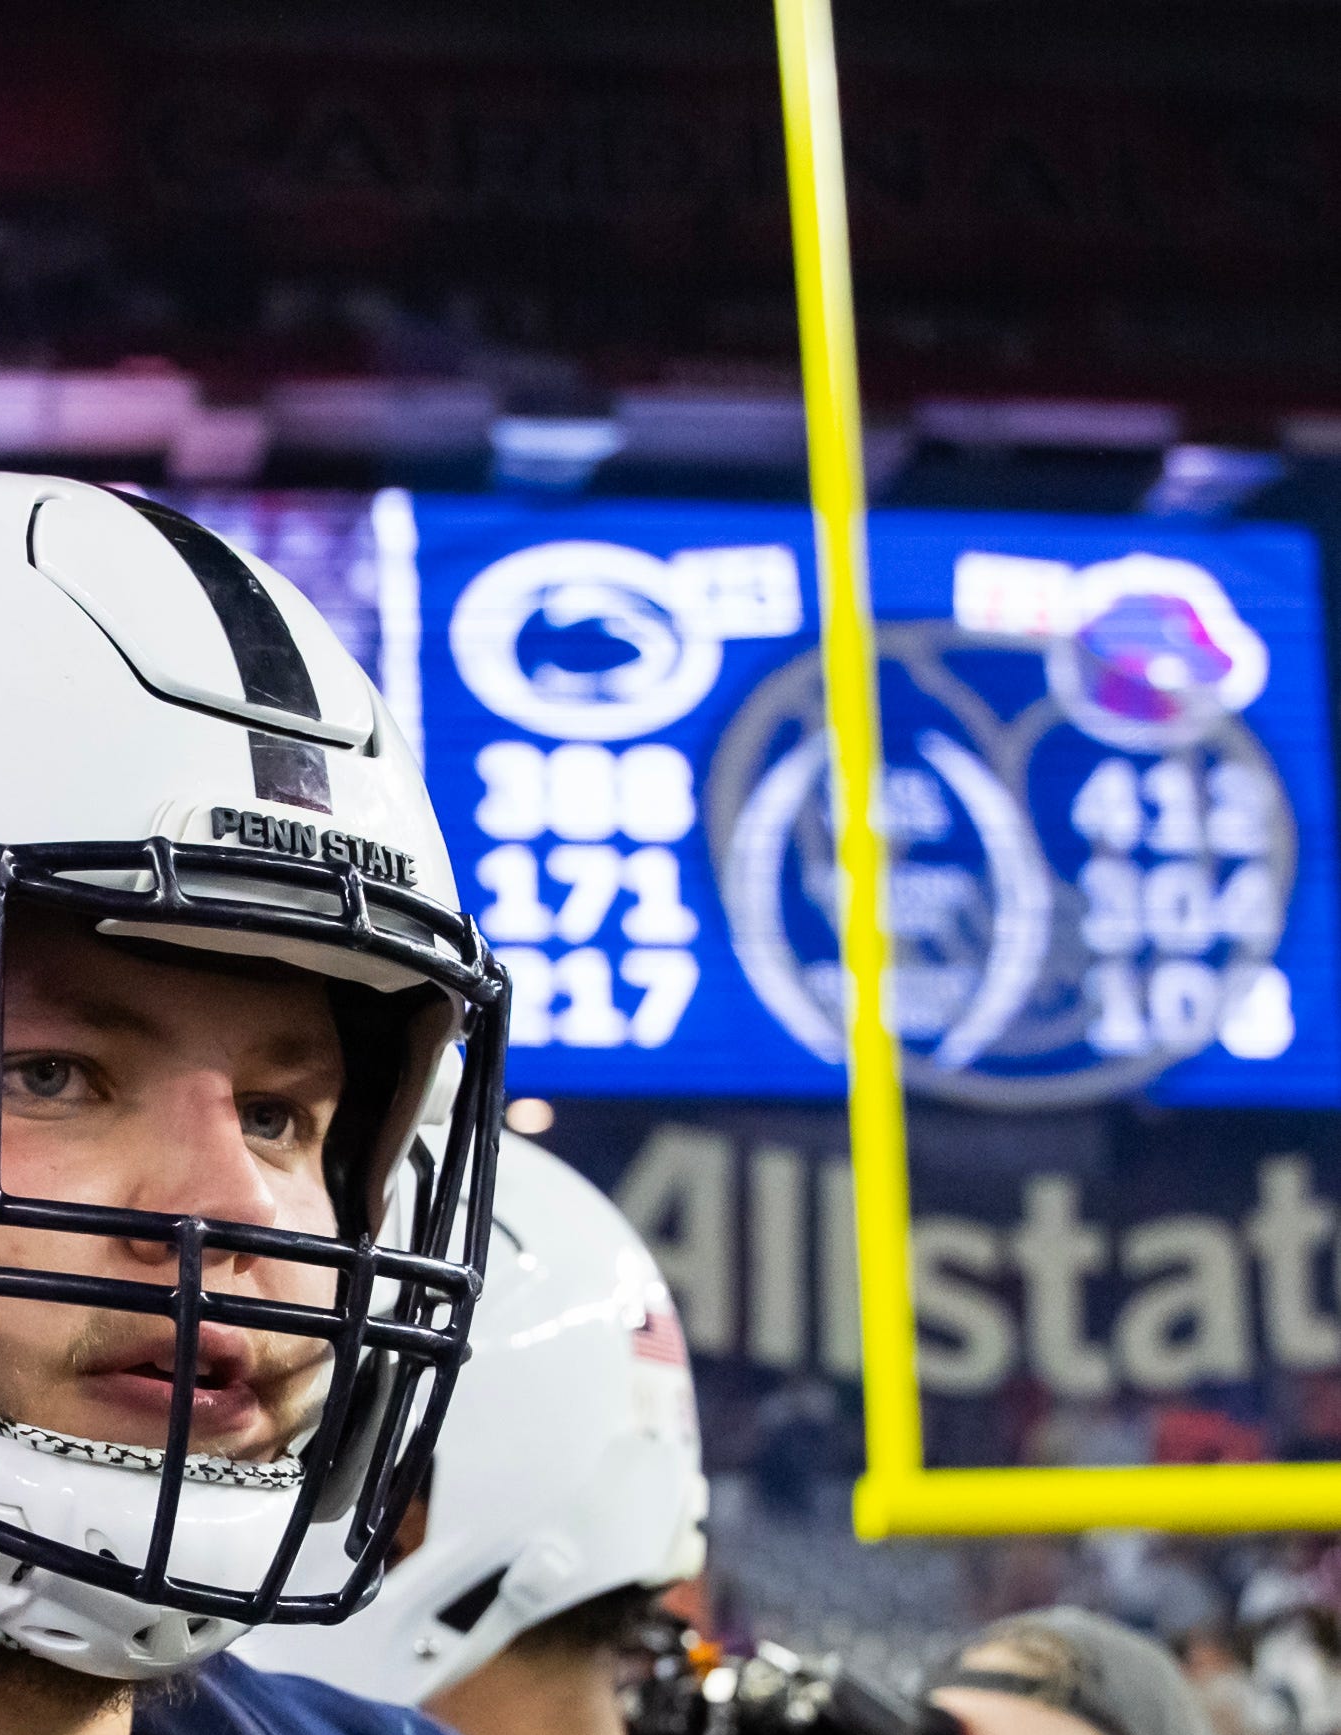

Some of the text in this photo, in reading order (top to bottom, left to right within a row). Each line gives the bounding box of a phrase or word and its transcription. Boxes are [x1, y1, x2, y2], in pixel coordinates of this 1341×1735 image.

[211, 806, 418, 888] PENN STATE
[475, 843, 699, 945] 171
[613, 1122, 1341, 1397] Allstat
